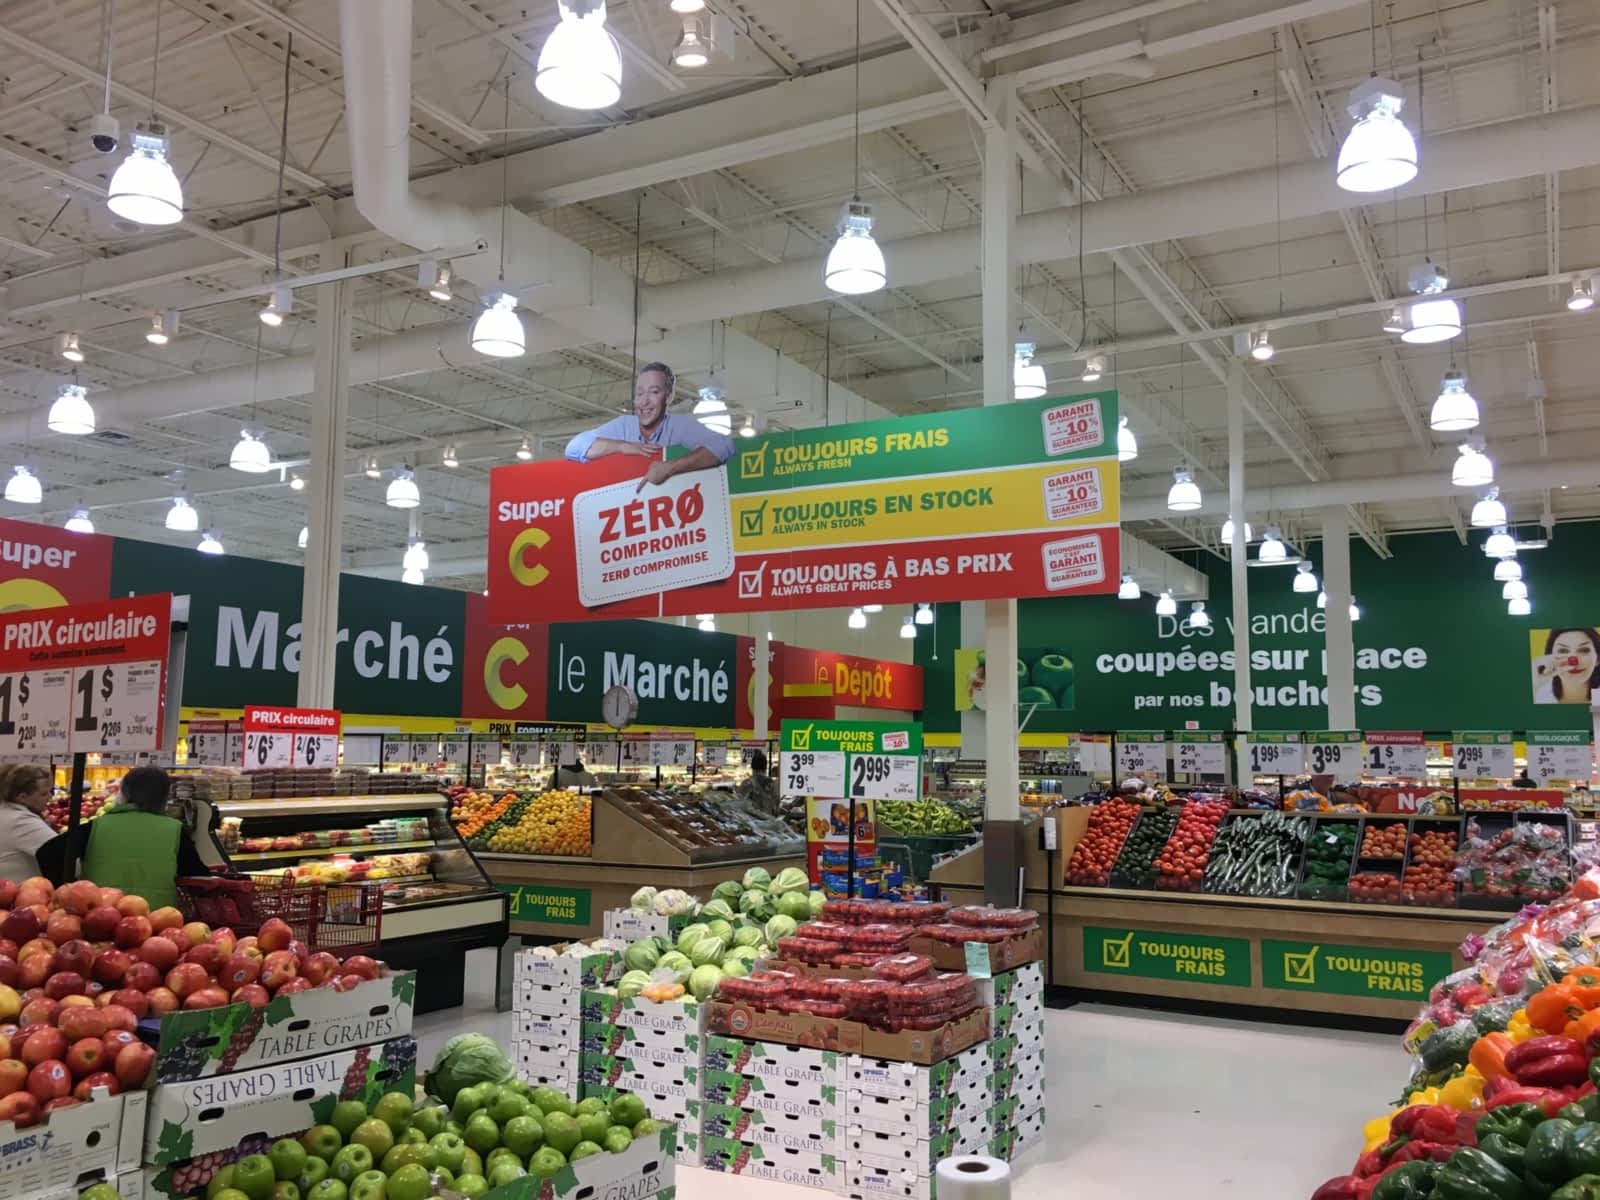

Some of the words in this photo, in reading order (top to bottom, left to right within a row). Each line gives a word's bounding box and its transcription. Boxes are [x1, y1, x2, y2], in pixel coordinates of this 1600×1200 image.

[1047, 403, 1094, 421] GARANTI
[773, 436, 878, 466] TOUJOURS
[885, 428, 949, 453] FRAIS
[773, 462, 815, 477] ALWAYS
[817, 457, 852, 471] FRESH
[1047, 470, 1093, 488] GARANTI
[498, 498, 565, 524] Super
[772, 498, 878, 524] TOUJOURS
[885, 493, 913, 514] EN
[920, 487, 994, 511] STOCK
[1052, 500, 1098, 516] GUARANTEED
[772, 521, 814, 535] ALWAYS
[816, 519, 828, 530] IN
[830, 517, 865, 530] STOCK
[0, 539, 77, 569] uper
[600, 528, 707, 565] COMPROMIS
[508, 528, 551, 587] C
[633, 551, 709, 576] COMPROMISE
[1050, 552, 1097, 570] GARANTI
[771, 560, 876, 587] TOUJOURS
[883, 556, 898, 579] À
[904, 557, 950, 578] BAS
[957, 552, 1014, 575] PRIX
[771, 583, 813, 597] ALWAYS
[815, 580, 849, 594] GREAT
[851, 579, 892, 592] PRICES
[4, 619, 53, 651] PRIX
[56, 611, 157, 646] circulaire
[1158, 614, 1215, 638] Des
[1096, 645, 1236, 677] coupées
[1251, 649, 1309, 671] sur
[1321, 647, 1428, 676] ace
[558, 643, 585, 692] le
[603, 650, 729, 704] Marché
[814, 658, 829, 686] le
[835, 661, 893, 704] Dépôt
[1134, 696, 1164, 710] par
[1169, 695, 1204, 707] nos
[252, 711, 282, 724] PRIX
[283, 714, 336, 726] circulaire
[489, 722, 512, 734] PRIX
[816, 730, 875, 741] TOUJOURS
[840, 741, 874, 752] FRAIS
[526, 893, 576, 907] TOUJOURS
[546, 906, 576, 918] FRAIS
[1139, 942, 1226, 962] TOUJOURS
[1176, 959, 1226, 976] FRAIS
[1326, 956, 1424, 978] TOUJOURS
[1367, 974, 1425, 993] FRAIS
[623, 1014, 649, 1027] TABLE
[651, 1017, 687, 1032] GRAPES
[258, 1032, 316, 1060] TABLE
[323, 1017, 393, 1045] GRAPES
[624, 1046, 650, 1059] TABLE
[651, 1048, 688, 1064] GRAPES
[284, 1060, 341, 1087] TABLE
[752, 1062, 780, 1076] TABLE
[784, 1066, 825, 1082] GRAPES
[192, 1073, 276, 1107] GRAPES
[623, 1079, 649, 1091] TABLE
[651, 1081, 687, 1097] GRAPES
[751, 1096, 780, 1110] TABLE
[783, 1100, 824, 1116] GRAPES
[751, 1129, 780, 1144] TABLE
[783, 1134, 824, 1150] GRAPES
[751, 1164, 780, 1179] TABLE
[783, 1169, 825, 1186] GRAPES
